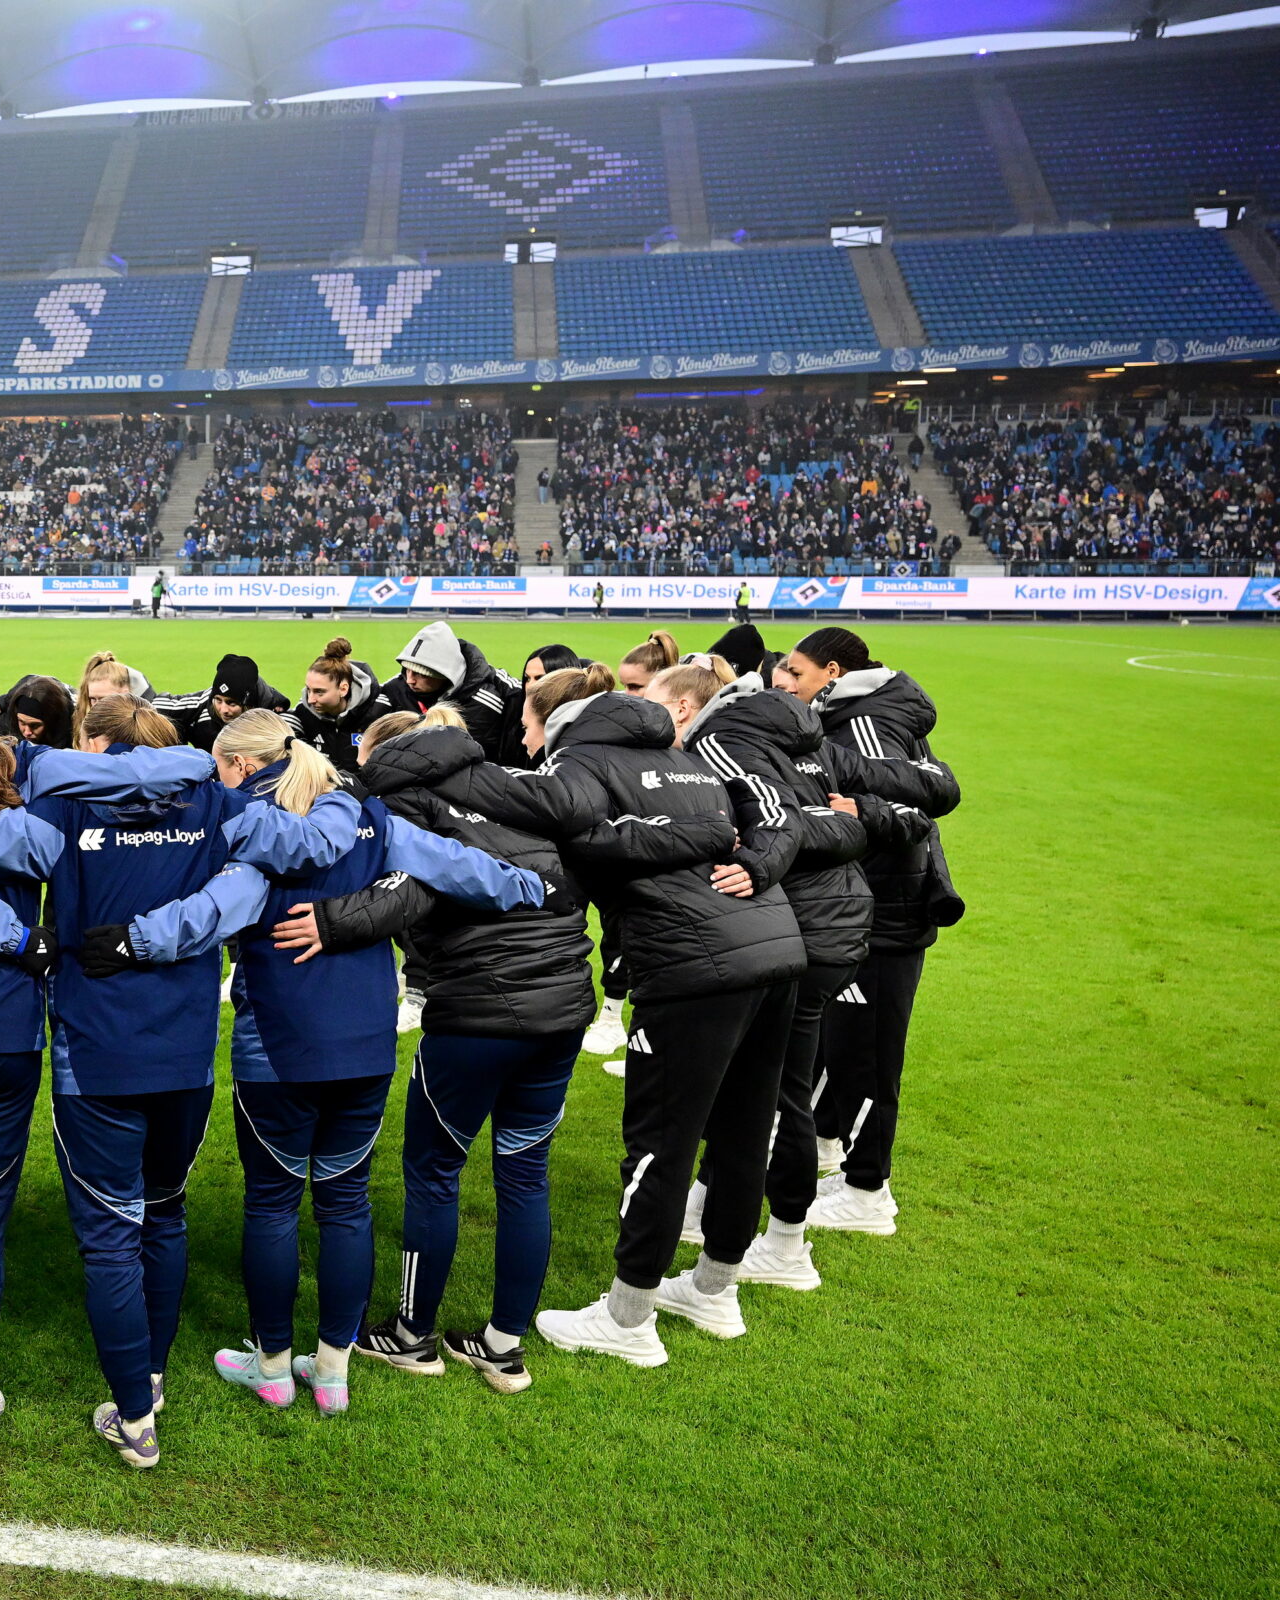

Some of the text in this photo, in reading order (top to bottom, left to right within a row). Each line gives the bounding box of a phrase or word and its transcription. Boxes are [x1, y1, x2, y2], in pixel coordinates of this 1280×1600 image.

[52, 579, 119, 590] Sparda-Bank
[169, 583, 340, 599] Karte im HSV-Design.
[442, 580, 516, 591] Sparda-Bank
[569, 583, 760, 600] Kae im HSV-Desi.
[874, 579, 955, 592] Sparda-Bank
[1015, 584, 1228, 603] Karte im HSV-Design.
[115, 828, 205, 847] Hapag-Lloyd
